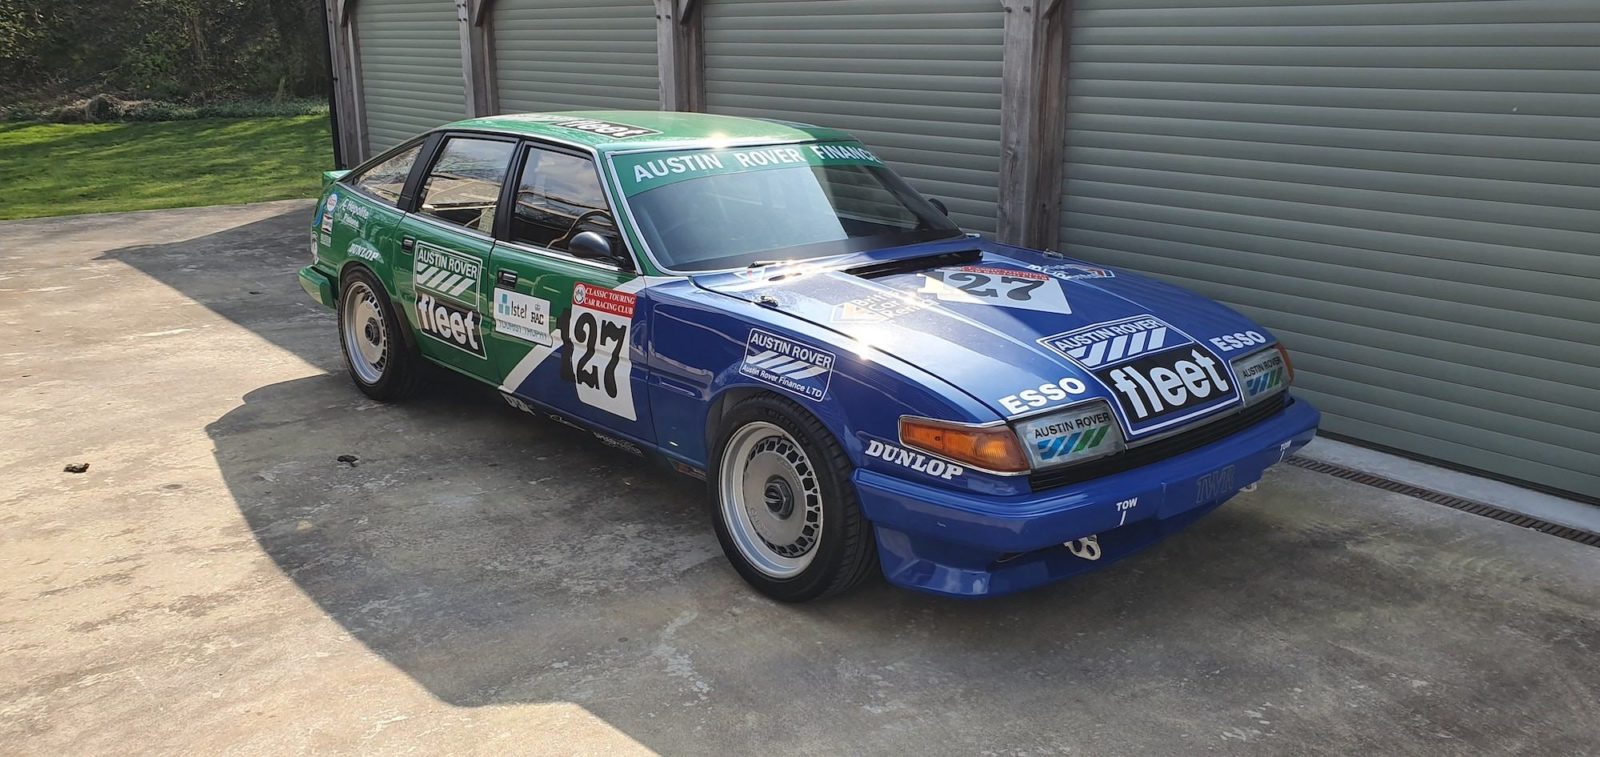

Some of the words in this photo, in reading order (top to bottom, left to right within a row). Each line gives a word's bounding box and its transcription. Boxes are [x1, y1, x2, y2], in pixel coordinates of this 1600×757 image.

[634, 154, 723, 183] AUSTIN
[738, 147, 806, 169] ROVER
[349, 243, 380, 261] DUNLOP
[417, 248, 447, 269] AUSTIN
[449, 259, 478, 279] ROVER
[584, 287, 609, 299] CLASSIC
[609, 292, 635, 305] TOURING
[584, 297, 596, 307] CAR
[595, 300, 617, 312] RACING
[617, 305, 634, 315] CLUB
[417, 294, 479, 351] fleet
[511, 301, 527, 319] Istel
[531, 311, 545, 325] RAC
[1054, 324, 1116, 352] AUSTIN
[1115, 318, 1167, 339] ROVER
[1208, 330, 1266, 352] ESSO
[750, 333, 791, 355] AUSTIN
[791, 345, 832, 369] ROVER
[742, 364, 759, 375] Austin
[760, 369, 778, 381] Rover
[779, 376, 805, 392] Finance
[806, 385, 822, 398] LTD
[1242, 363, 1264, 378] AUSTIN
[1264, 356, 1281, 369] ROVER
[997, 377, 1087, 415] ESSO
[1110, 349, 1229, 418] fleet
[1034, 421, 1074, 439] AUSTIN
[1075, 411, 1111, 429] ROVER
[865, 439, 963, 480] DUNLOP
[1115, 497, 1138, 512] TOW
